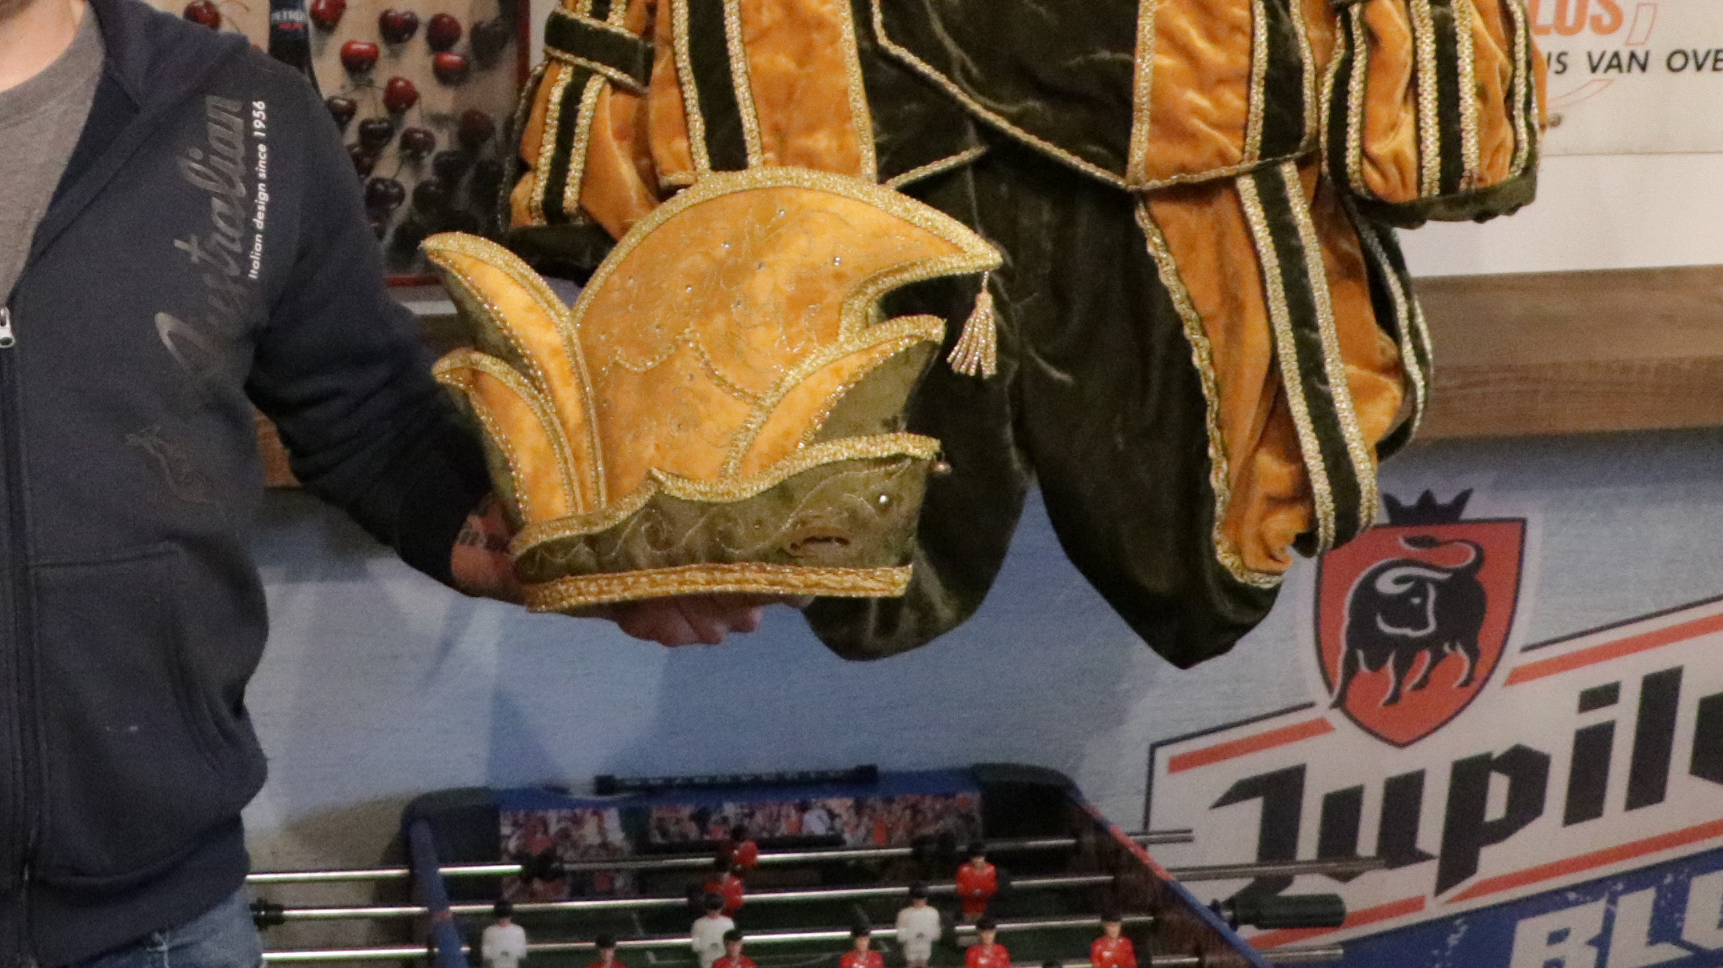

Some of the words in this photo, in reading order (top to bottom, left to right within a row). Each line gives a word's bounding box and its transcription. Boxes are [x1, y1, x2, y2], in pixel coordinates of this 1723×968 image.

[1587, 49, 1650, 73] VAN
[252, 99, 267, 137] 1956
[257, 143, 267, 181] since
[252, 182, 270, 231] design
[248, 233, 263, 280] Italian
